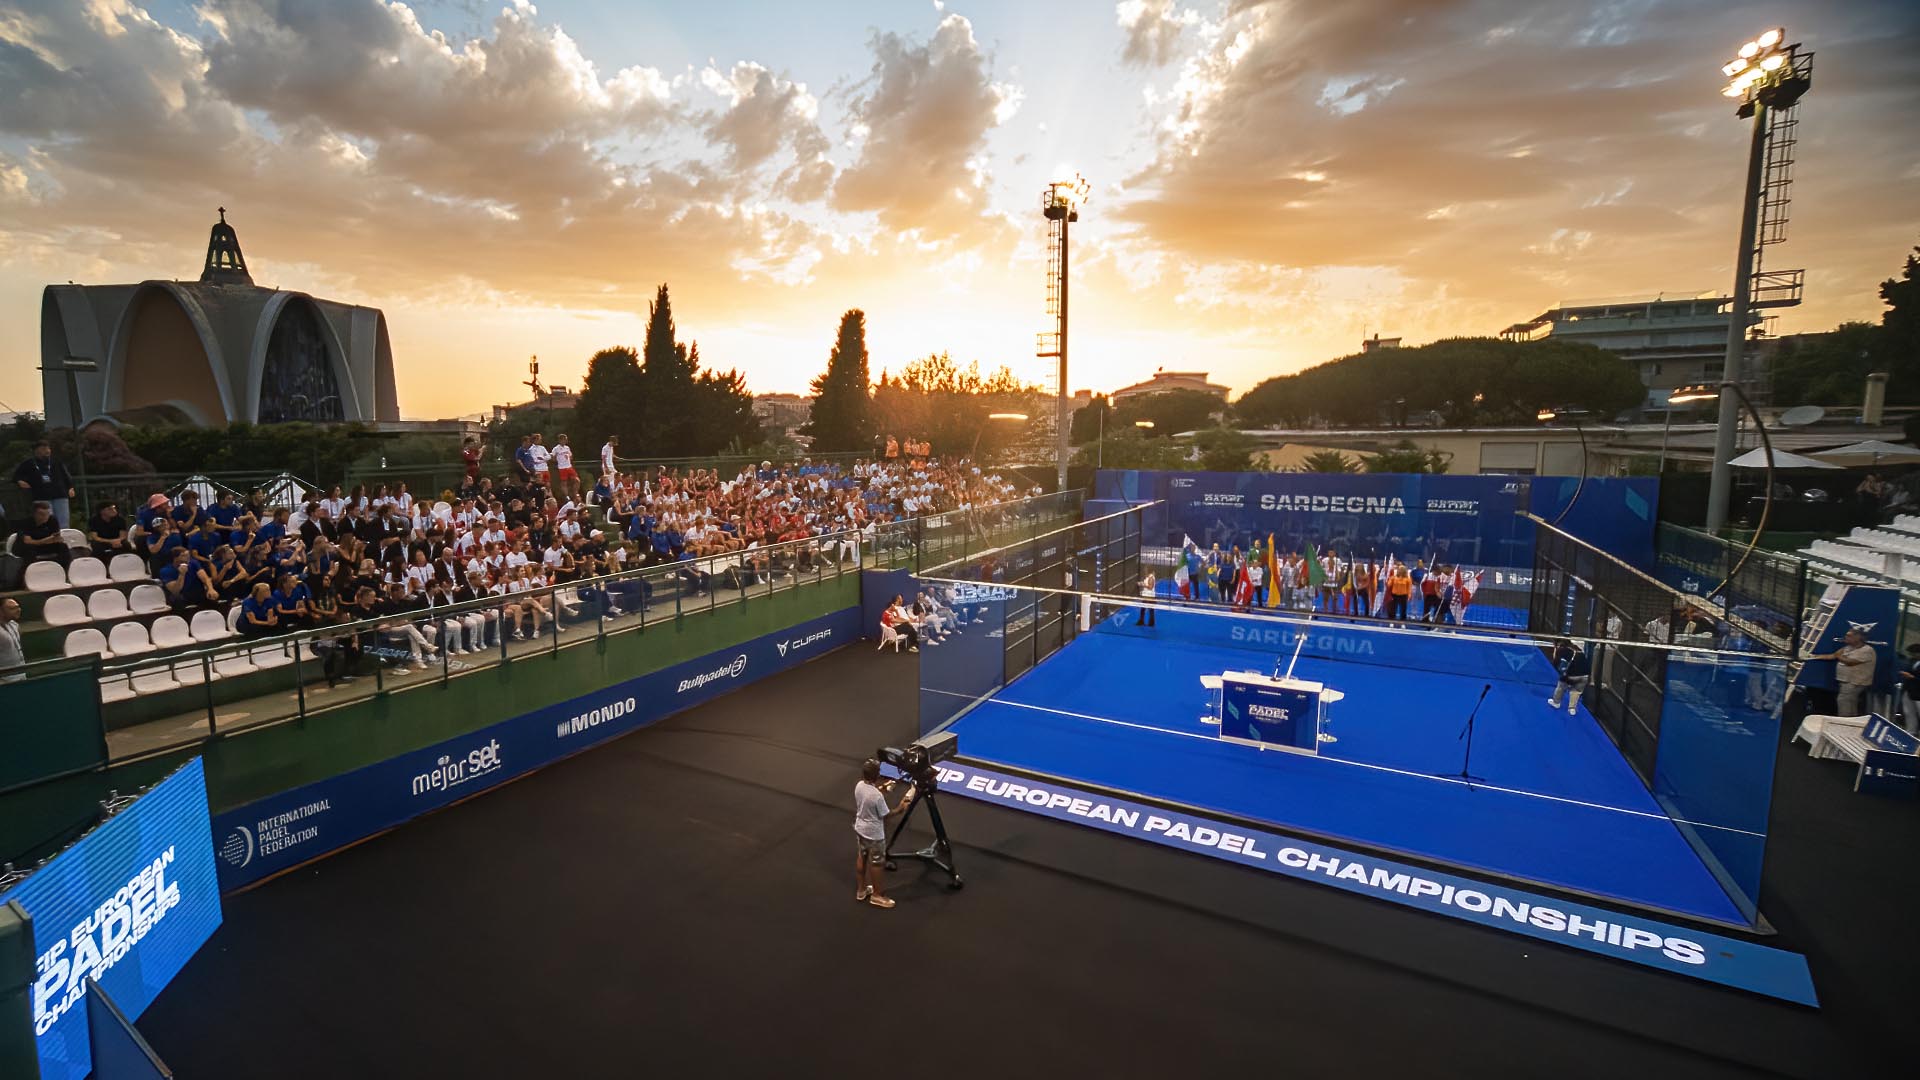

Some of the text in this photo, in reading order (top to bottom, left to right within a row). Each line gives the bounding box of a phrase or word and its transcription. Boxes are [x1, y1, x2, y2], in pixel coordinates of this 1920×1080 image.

[1260, 494, 1405, 514] SARDEGNA
[792, 629, 832, 649] CUPRA
[1231, 626, 1374, 655] SARDEGNA
[677, 663, 732, 693] Bullpadel
[571, 697, 636, 734] MONDO
[258, 799, 331, 832] INTERNATIONAL
[259, 826, 290, 844] PADEL
[260, 826, 318, 856] FEDERATION
[966, 775, 1140, 828] EUROPEAN
[1144, 815, 1267, 859] PADEL
[1276, 847, 1705, 965] CHAMPIONSHIPS
[72, 846, 175, 945] EUROPEAN
[34, 873, 178, 1022] PADEL
